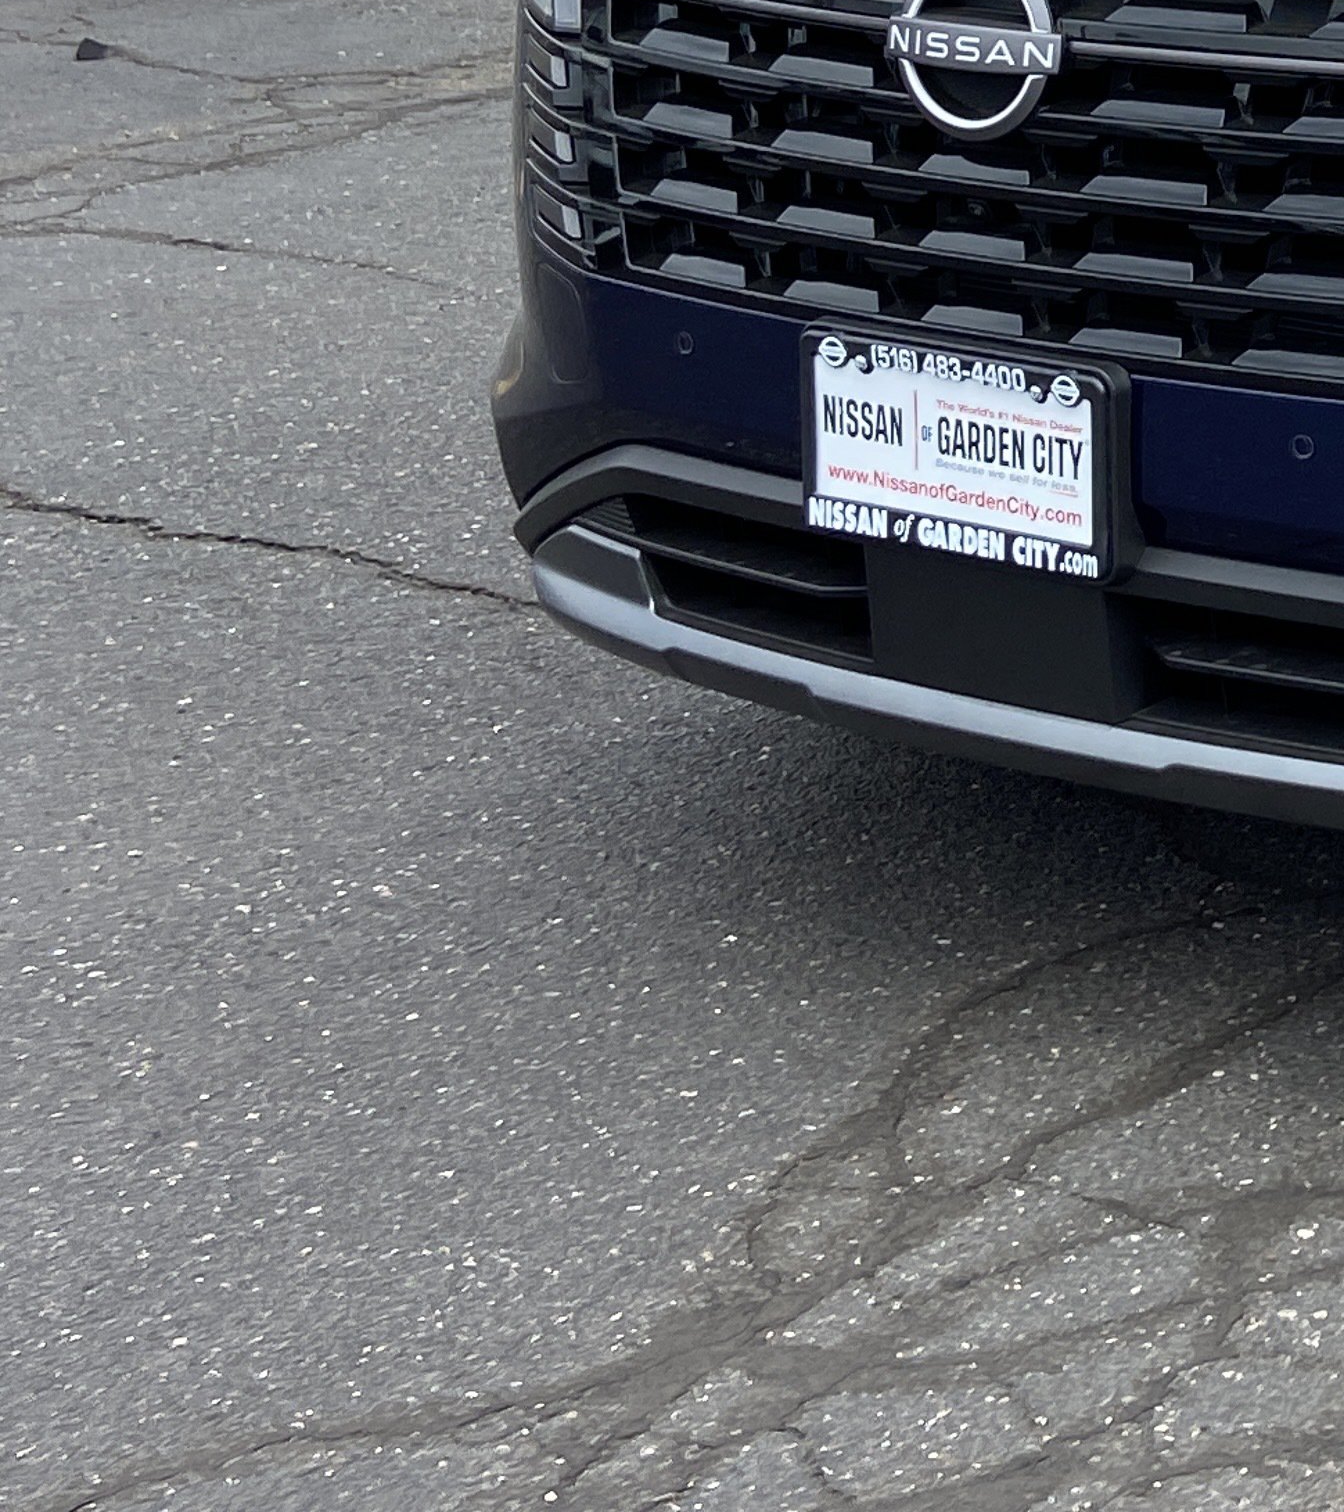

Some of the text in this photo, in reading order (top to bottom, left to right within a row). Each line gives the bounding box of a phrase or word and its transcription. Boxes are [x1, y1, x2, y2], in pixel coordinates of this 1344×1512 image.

[889, 24, 1054, 69] NISSAN
[870, 344, 1027, 392] (516) 483-4400
[823, 394, 1083, 480] NISSAN OF GARDEN CITY
[936, 399, 955, 411] The
[1012, 413, 1047, 428] Nissan
[1050, 420, 1083, 434] Dealer
[827, 464, 1082, 526] www.NissanofGardenCity.com
[808, 496, 1098, 579] NISSAN of GARDEN CITY.com
